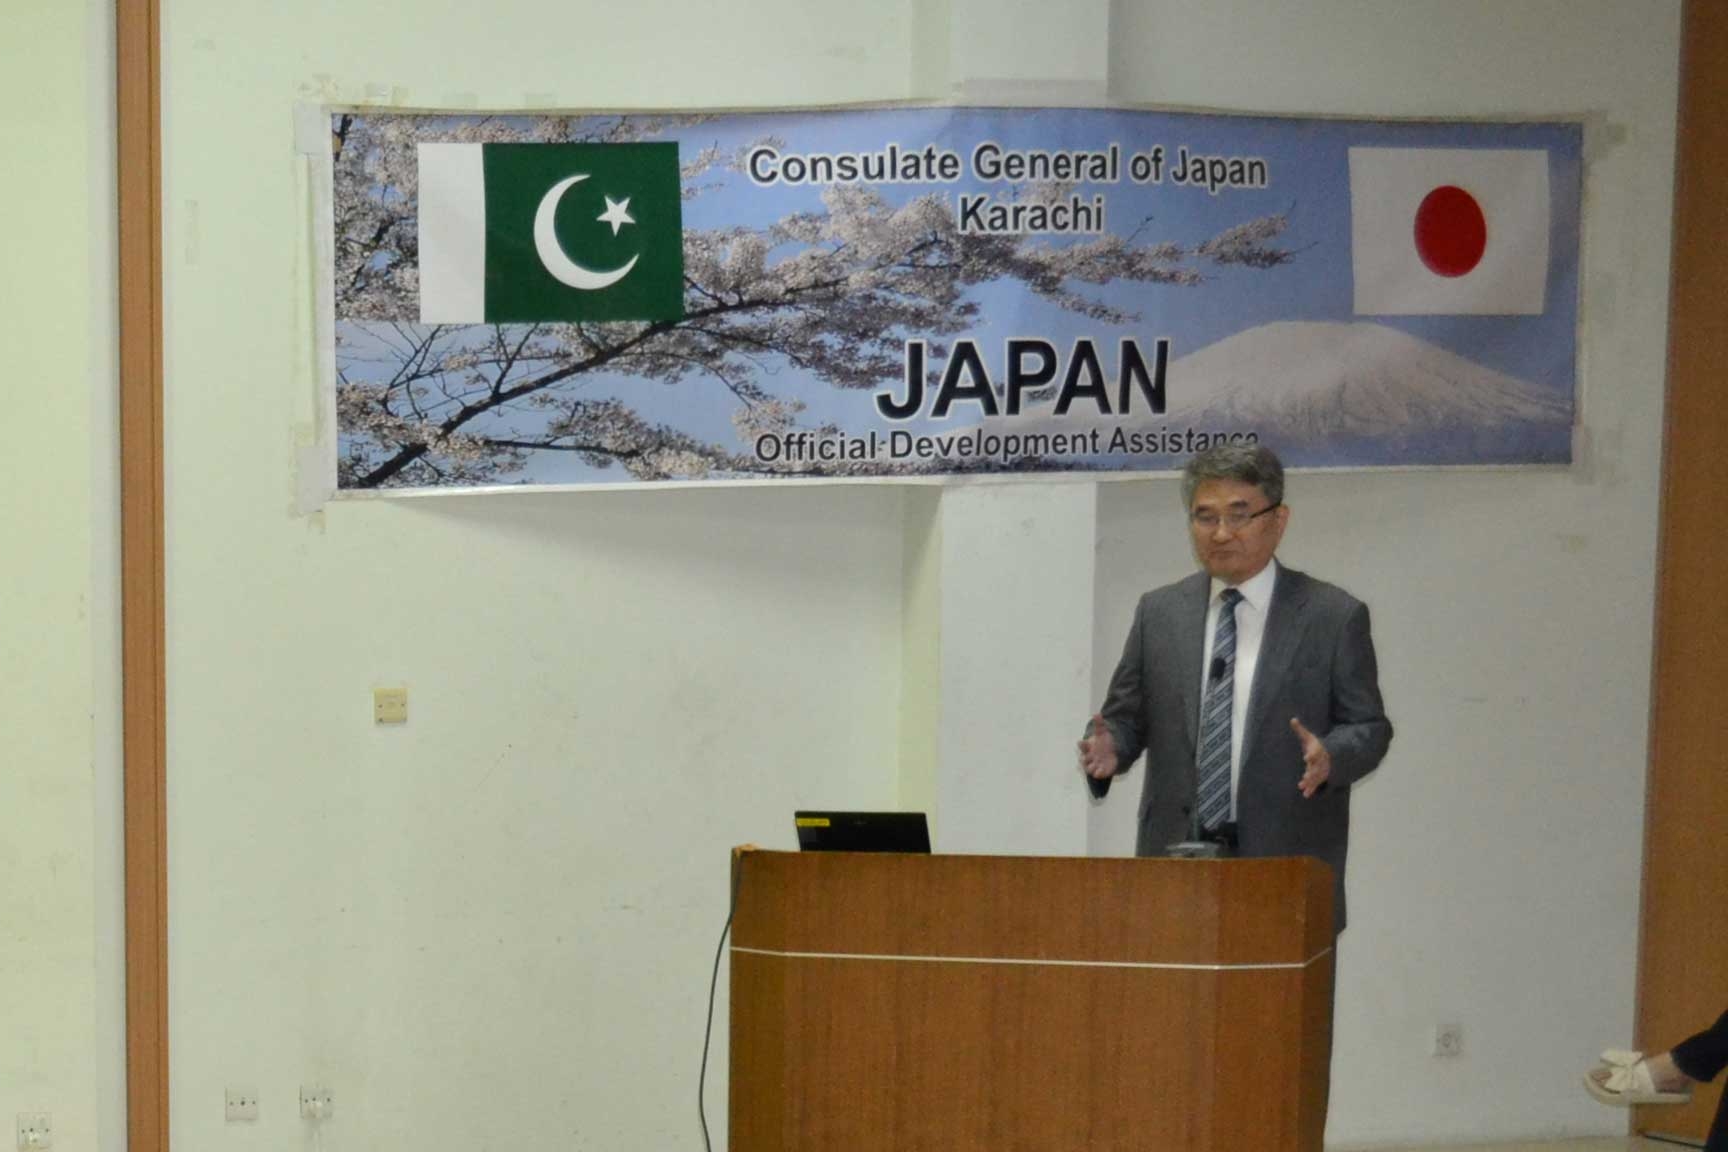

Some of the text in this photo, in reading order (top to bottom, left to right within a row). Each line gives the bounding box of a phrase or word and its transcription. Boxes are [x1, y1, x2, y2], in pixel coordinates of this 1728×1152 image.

[748, 143, 1268, 193] Consulate General of Japan
[959, 195, 1104, 232] Karachi
[874, 338, 1170, 421] JAPAN
[754, 429, 877, 463] Official
[888, 427, 1101, 464] Development
